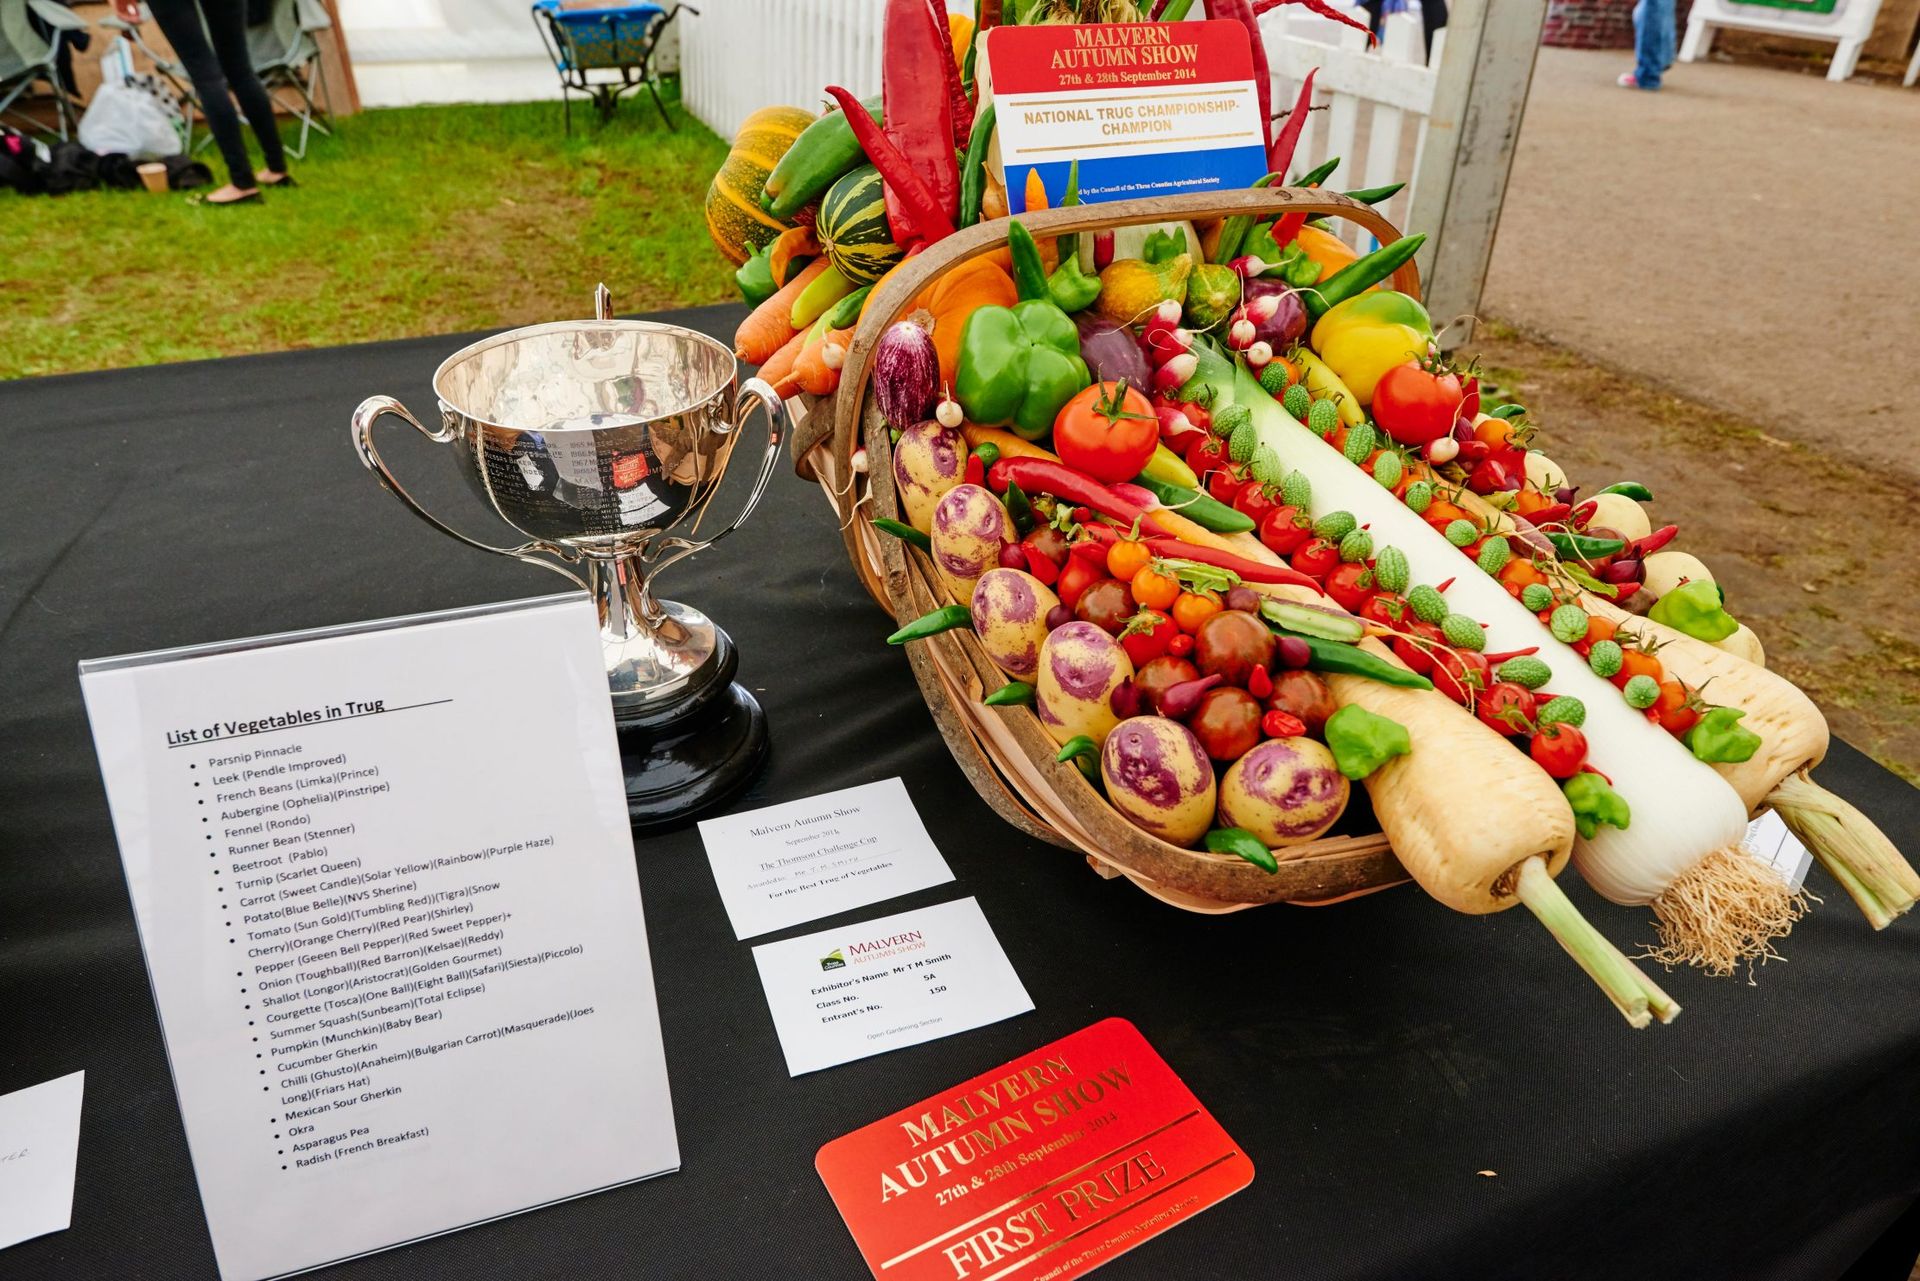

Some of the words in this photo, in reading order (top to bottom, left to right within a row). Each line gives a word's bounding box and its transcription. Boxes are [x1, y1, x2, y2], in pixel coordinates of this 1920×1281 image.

[1073, 26, 1171, 49] MALVERN
[1051, 48, 1138, 69] AUTUMN
[1141, 44, 1199, 65] SHOW
[1058, 73, 1082, 86] 27th
[1084, 73, 1095, 83] &
[1097, 71, 1118, 83] 28th
[1121, 69, 1172, 84] September
[1174, 68, 1197, 79] 2014
[1024, 108, 1094, 125] NATIONAL
[1097, 106, 1134, 120] TRUG
[1102, 120, 1172, 136] CHAMPION
[1100, 185, 1120, 193] Council
[1173, 178, 1202, 187] Agricultural
[167, 728, 197, 745] List
[203, 723, 220, 738] of
[225, 710, 321, 734] Vegetables
[326, 706, 342, 719] in
[346, 699, 385, 713] Trug
[209, 752, 252, 767] Parsnip
[255, 744, 302, 759] Pinnacle
[213, 773, 239, 785] Leek
[243, 765, 285, 781] (Pendle
[288, 754, 347, 771] Improved)
[217, 789, 256, 803] French
[259, 783, 293, 795] Beans
[296, 766, 379, 790] (Limka)(Prince)
[221, 803, 280, 821] Aubergine
[282, 782, 390, 811] (Ophelia)(Pinstripe)
[225, 823, 263, 838] Fennel
[266, 815, 311, 832] (Rondo)
[750, 822, 791, 837] Malvern
[794, 813, 832, 827] Autumn
[834, 806, 861, 818] Show
[228, 841, 269, 855] Runner
[273, 835, 301, 847] Bean
[304, 824, 355, 843] (Stenner)
[760, 861, 774, 871] The
[776, 851, 815, 866] Thomson
[817, 841, 858, 856] Challenge
[859, 835, 877, 846] Cup
[785, 833, 820, 846] September
[233, 857, 282, 873] Beetroot
[289, 847, 328, 863] (Pablo)
[236, 877, 273, 890] Turnip
[276, 869, 317, 884] (Scarlet
[321, 858, 361, 874] Queen)
[240, 894, 275, 907] Carrot
[279, 885, 317, 900] (Sweet
[320, 869, 391, 891] Candle)(Solar
[395, 842, 523, 876] Yellow)(Rainbow)(Purple
[526, 835, 554, 849] Haze)
[769, 891, 783, 899] For
[785, 886, 797, 895] the
[799, 882, 817, 891] Best
[819, 876, 839, 886] Trug
[850, 862, 893, 877] Vegetables
[244, 906, 310, 924] Potato(Blue
[313, 891, 370, 910] Belle)(NVS
[372, 881, 417, 897] Sherine)
[247, 926, 291, 941] Tomato
[294, 920, 318, 933] (Sun
[321, 902, 405, 926] Gold)(Tumbling
[408, 882, 500, 907] Red))(Tigra)(Snow
[248, 933, 334, 958] Cherry)(Orange
[336, 920, 400, 939] Cherry)(Red
[403, 903, 473, 925] Pear)(Shirley)
[255, 959, 294, 974] Pepper
[298, 951, 338, 966] (Geeen
[340, 944, 360, 955] Bell
[363, 930, 428, 950] Pepper)(Red
[432, 923, 463, 936] Sweet
[466, 912, 512, 928] Pepper)+
[848, 930, 922, 956] MALVERN
[259, 978, 292, 990] Onion
[295, 957, 381, 984] (Toughball)(Red
[384, 929, 503, 964] Barron)(Kelsae)(Reddy)
[854, 950, 896, 965] AUTUMN
[898, 941, 926, 953] SHOW
[263, 992, 300, 1007] Shallot
[304, 959, 450, 999] (Longor)(Aristocrat)(Golden
[452, 946, 502, 964] Gourmet)
[266, 1005, 321, 1023] Courgette
[324, 991, 388, 1011] (Tosca)(One
[391, 976, 444, 995] Ball)(Eight
[447, 944, 583, 982] Ball)(Safari)(Siesta)(Piccolo)
[811, 978, 860, 995] Exhibitor's
[862, 971, 888, 982] Name
[893, 966, 905, 974] Mr
[925, 954, 951, 965] Smith
[929, 985, 946, 995] 150
[270, 1024, 316, 1039] Summer
[318, 992, 444, 1029] Squash(Sunbeam)(Total
[447, 983, 485, 999] Eclipse)
[816, 997, 841, 1009] Class
[822, 1008, 864, 1023] Entrant's
[867, 1004, 882, 1012] No.
[271, 1039, 318, 1056] Pumpkin
[322, 1018, 412, 1046] (Munchkin)(Baby
[414, 1010, 443, 1024] Bear)
[867, 1031, 884, 1040] Open
[886, 1022, 918, 1035] Gardening
[919, 1017, 942, 1026] Section
[278, 1054, 332, 1072] Cucumber
[336, 1043, 378, 1058] Gherkin
[281, 1075, 307, 1088] Chilli
[310, 1038, 463, 1083] (Ghusto)(Anaheim)(Bulgarian
[465, 1006, 594, 1044] Carrot)(Masquerade)(Joes
[282, 1083, 345, 1105] Long)(Friars
[348, 1076, 371, 1089] Hat)
[285, 1104, 331, 1121] Mexican
[333, 1098, 357, 1109] Sour
[360, 1086, 402, 1102] Gherkin
[899, 1052, 1076, 1149] MALVERN
[288, 1124, 314, 1137] Okra
[292, 1132, 348, 1152] Asparagus
[350, 1127, 369, 1138] Pea
[880, 1108, 1039, 1203] AUTUMN
[1040, 1061, 1134, 1128] SHOW
[296, 1153, 332, 1168] Radish
[334, 1142, 374, 1159] (French
[376, 1127, 429, 1147] Breakfast)
[934, 1181, 969, 1206] 27th
[971, 1174, 986, 1190] &
[986, 1156, 1017, 1183] 28th
[1019, 1127, 1087, 1169] September
[1088, 1111, 1119, 1138] 2014
[942, 1201, 1058, 1281] FIRST
[1052, 1149, 1167, 1223] PRIZE
